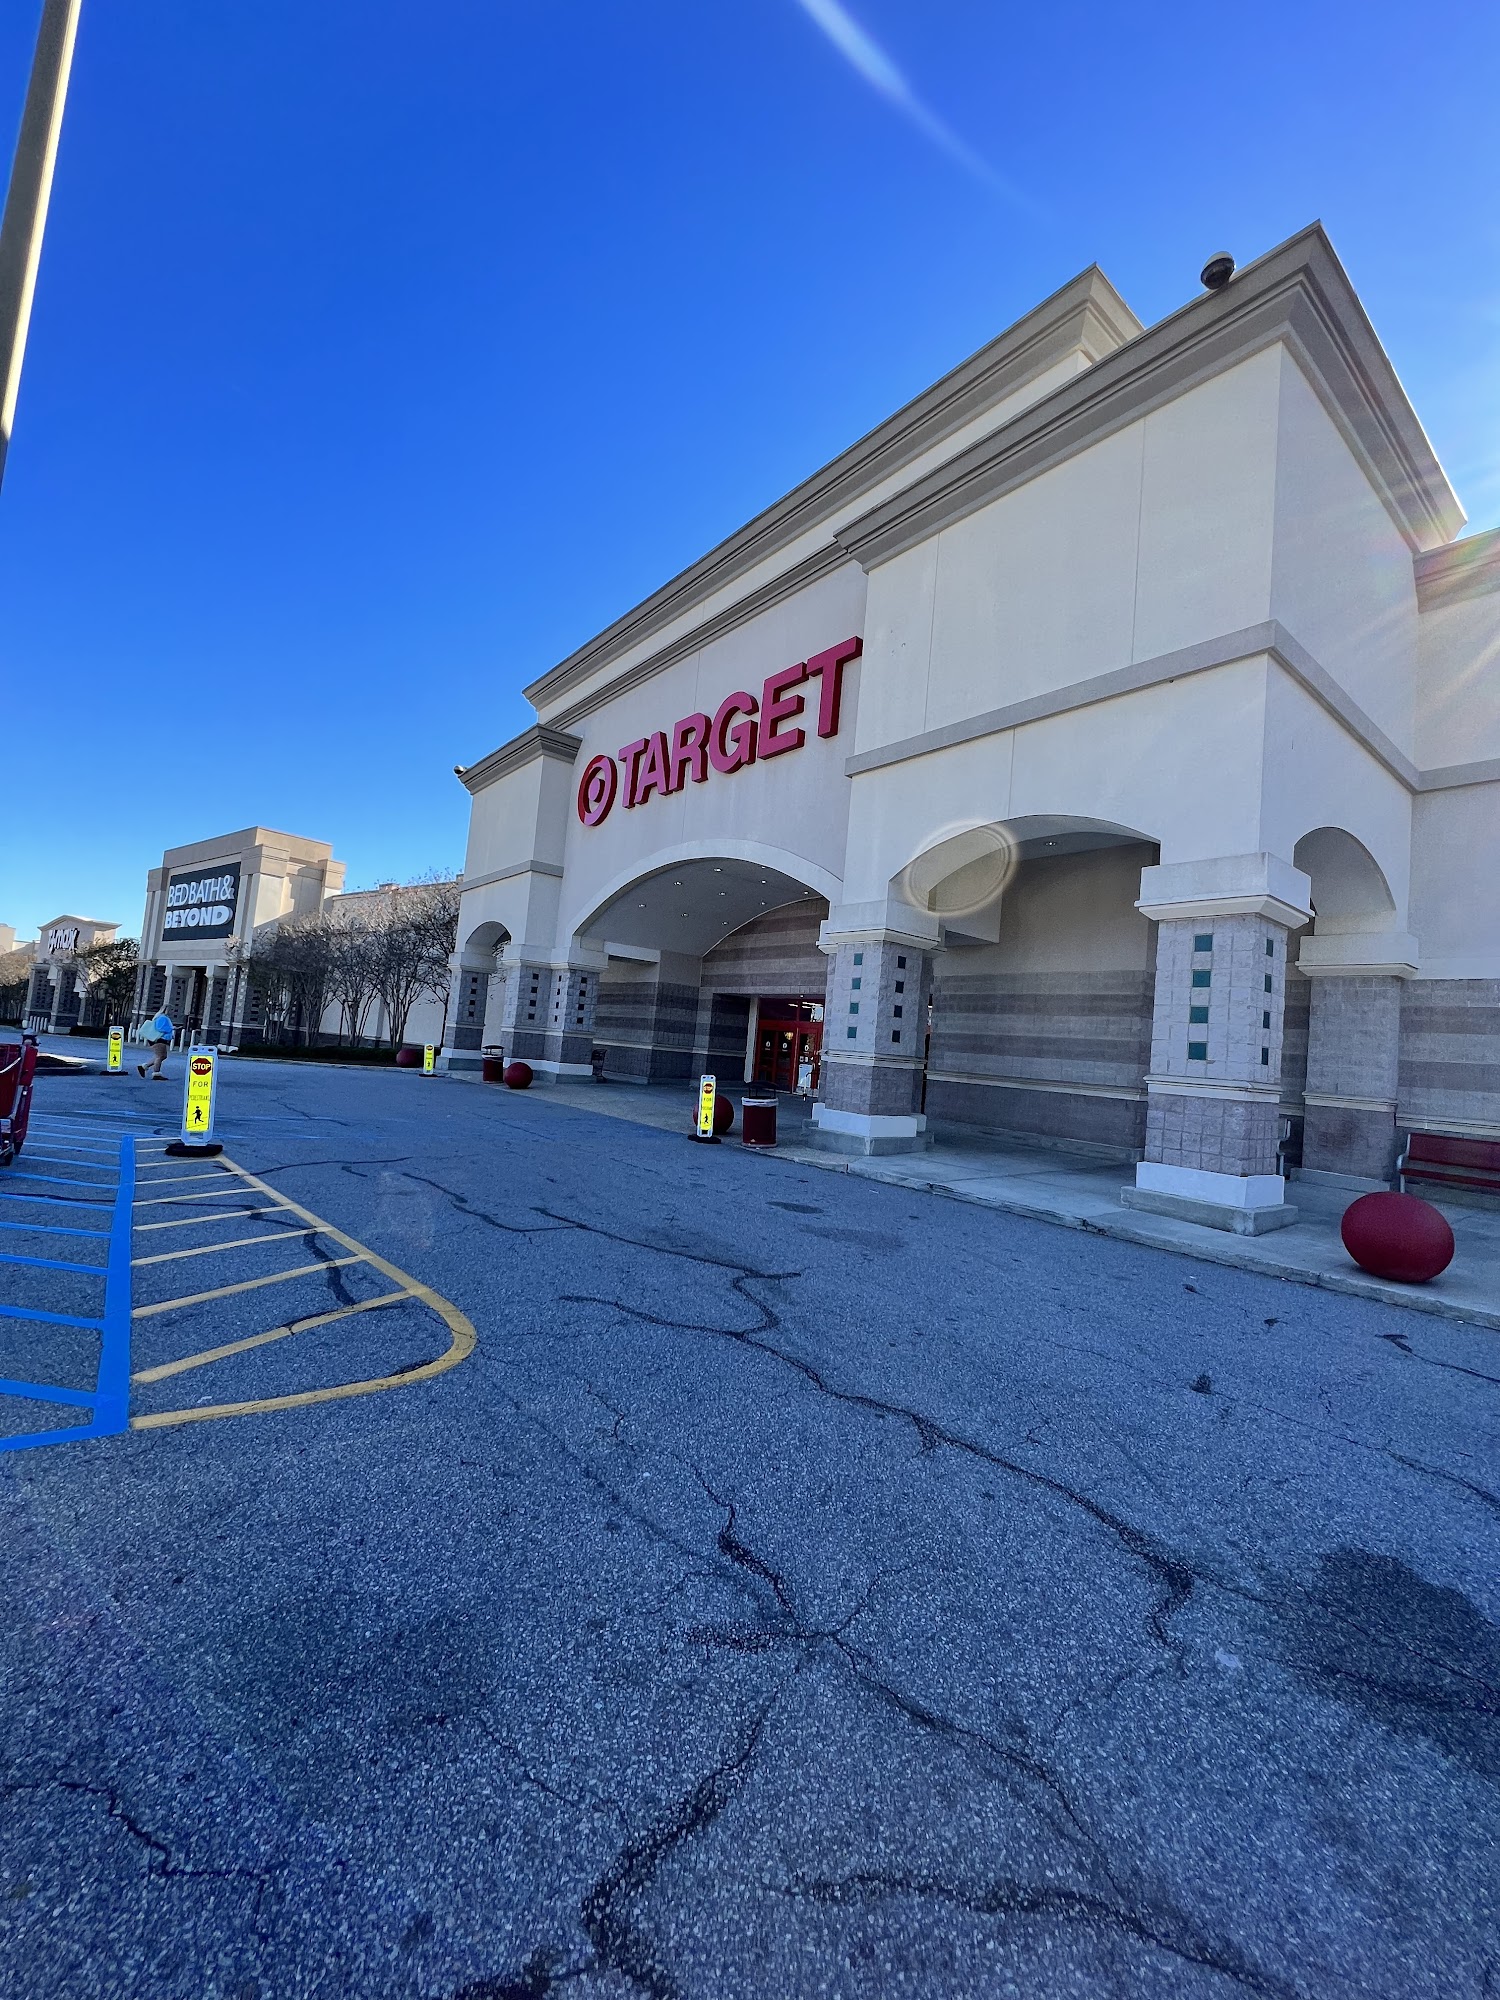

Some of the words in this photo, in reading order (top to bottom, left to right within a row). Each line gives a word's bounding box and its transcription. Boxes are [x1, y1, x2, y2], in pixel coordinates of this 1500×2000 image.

[618, 635, 864, 809] TARGET
[167, 883, 189, 907] BED
[188, 876, 223, 905] BATH
[220, 874, 235, 901] &
[164, 905, 234, 929] BEYOND
[192, 1062, 211, 1071] STOP
[192, 1080, 209, 1088] FOR
